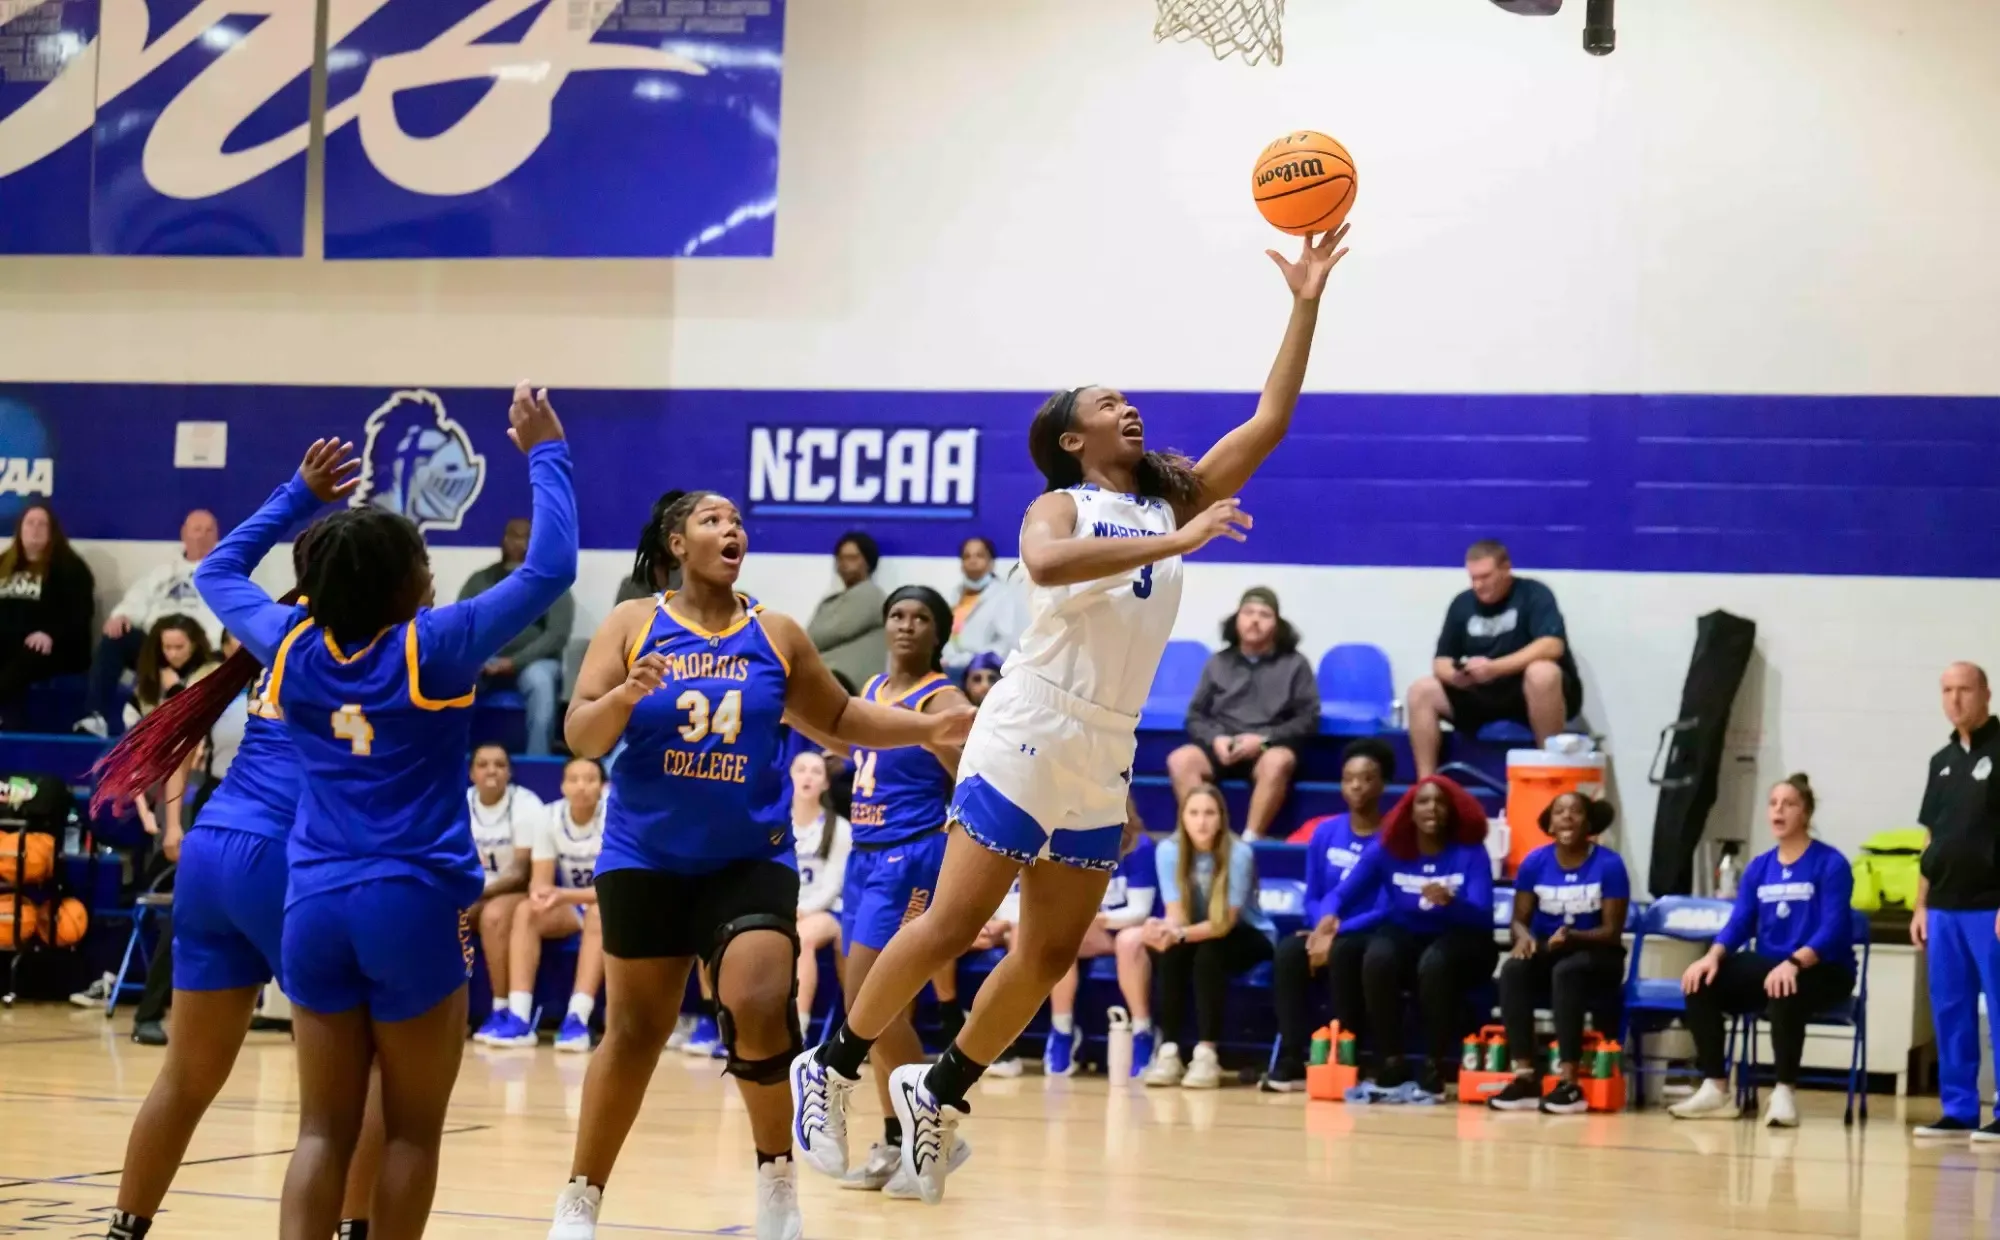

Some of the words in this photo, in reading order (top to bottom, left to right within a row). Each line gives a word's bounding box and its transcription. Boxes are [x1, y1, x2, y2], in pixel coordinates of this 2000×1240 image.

[1256, 158, 1325, 187] Wilson
[750, 428, 977, 504] NCCAA
[672, 652, 749, 682] MORRIS
[330, 703, 375, 757] 4
[675, 689, 742, 745] 34
[663, 748, 749, 784] COLLEGE
